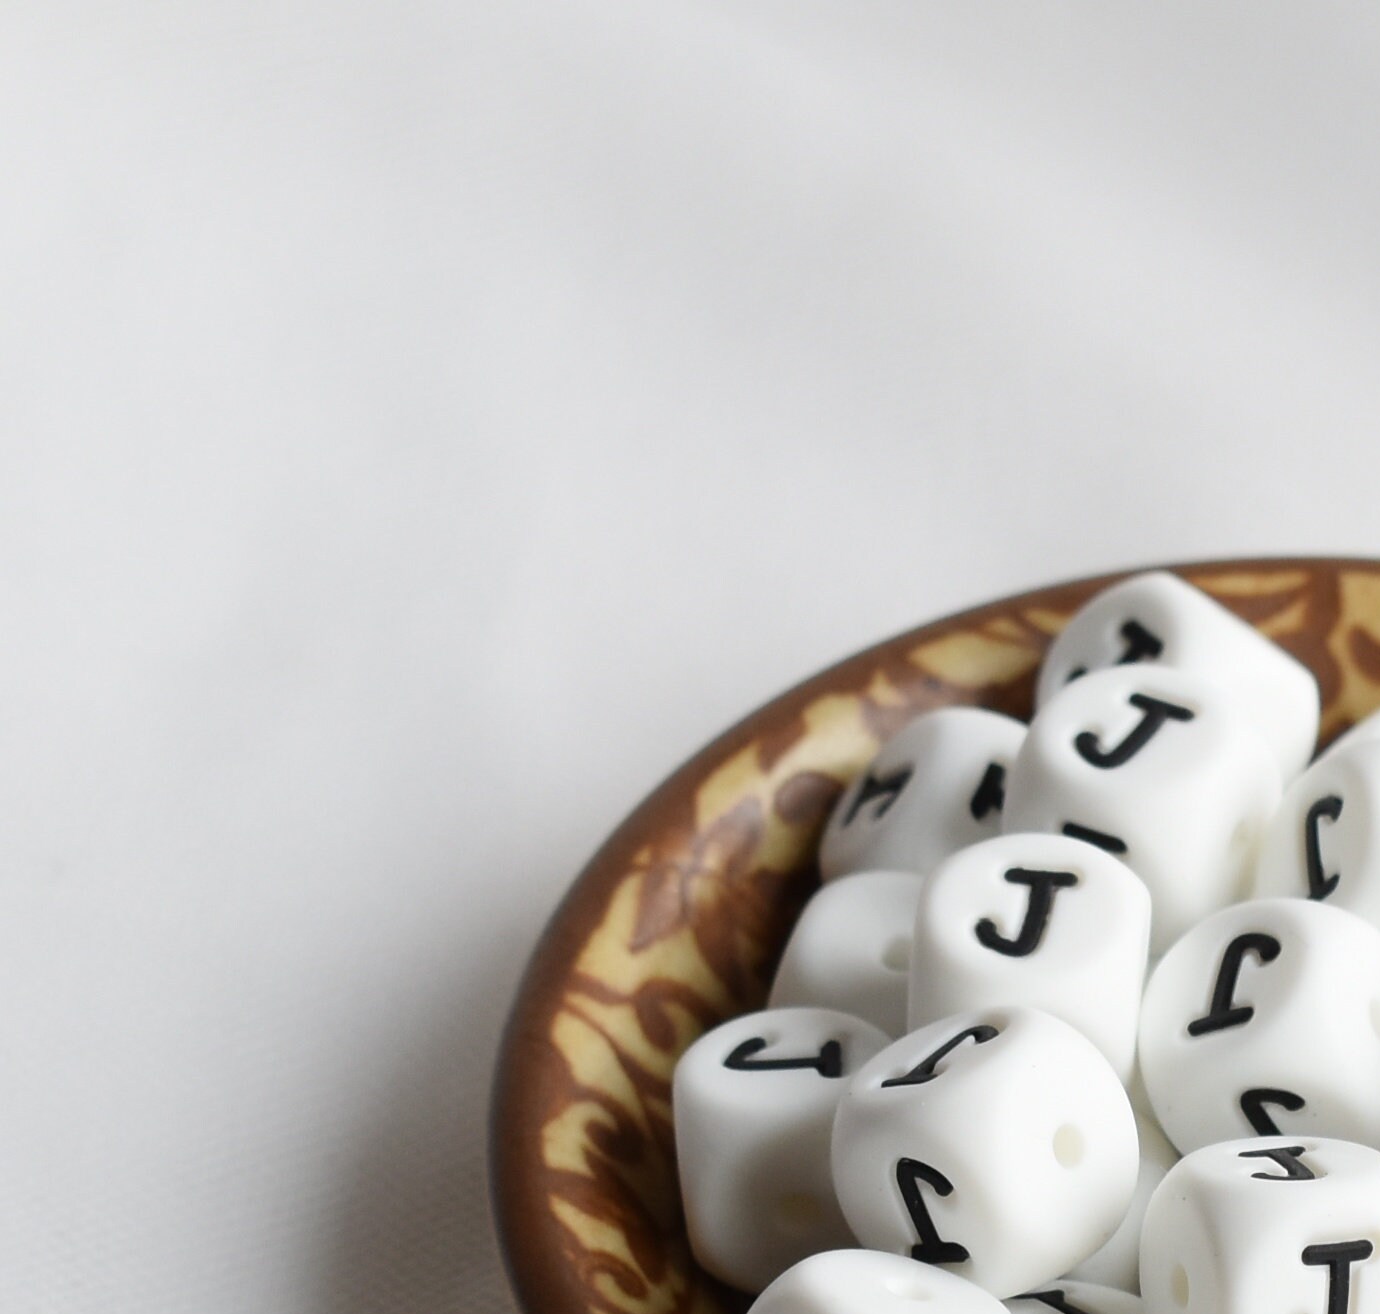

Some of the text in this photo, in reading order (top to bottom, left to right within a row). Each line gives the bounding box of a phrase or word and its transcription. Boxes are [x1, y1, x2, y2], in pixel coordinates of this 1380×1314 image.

[1074, 693, 1194, 769] J
[1304, 795, 1343, 900] J
[974, 867, 1079, 957] J
[1186, 931, 1282, 1037] J
[723, 1036, 843, 1078] J
[880, 1024, 999, 1088] J
[1237, 1145, 1316, 1181] J
[895, 1156, 970, 1265] J
